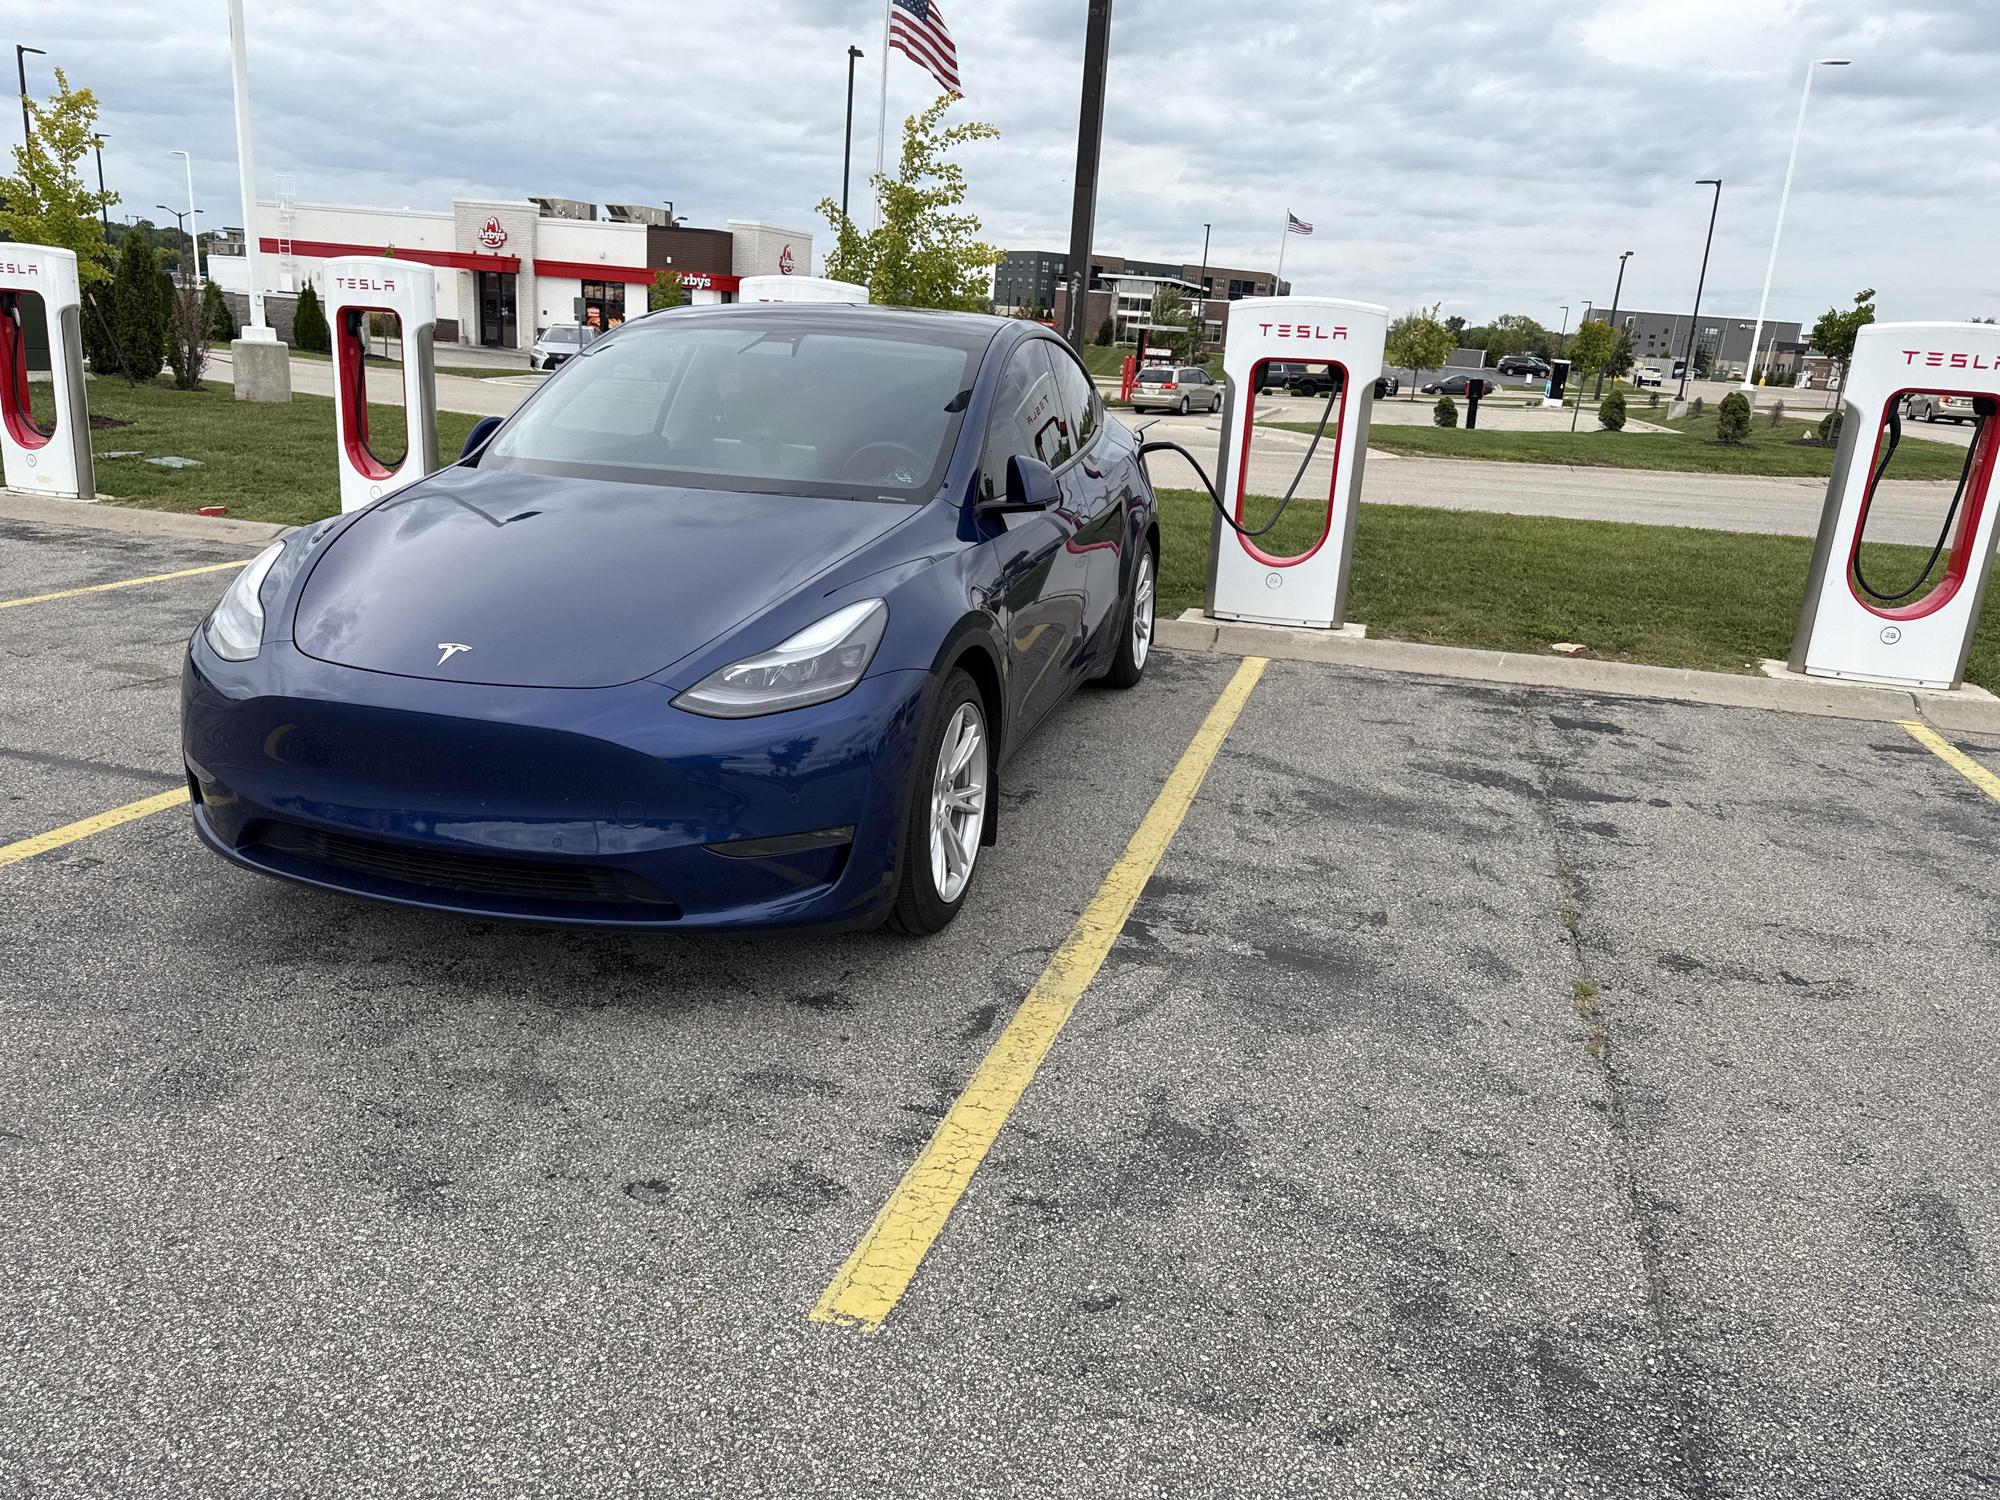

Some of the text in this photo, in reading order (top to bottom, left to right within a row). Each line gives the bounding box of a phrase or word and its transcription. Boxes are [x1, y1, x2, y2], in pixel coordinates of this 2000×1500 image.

[479, 229, 506, 241] Arby's
[336, 278, 395, 291] TESLA
[1259, 323, 1348, 340] TESLA
